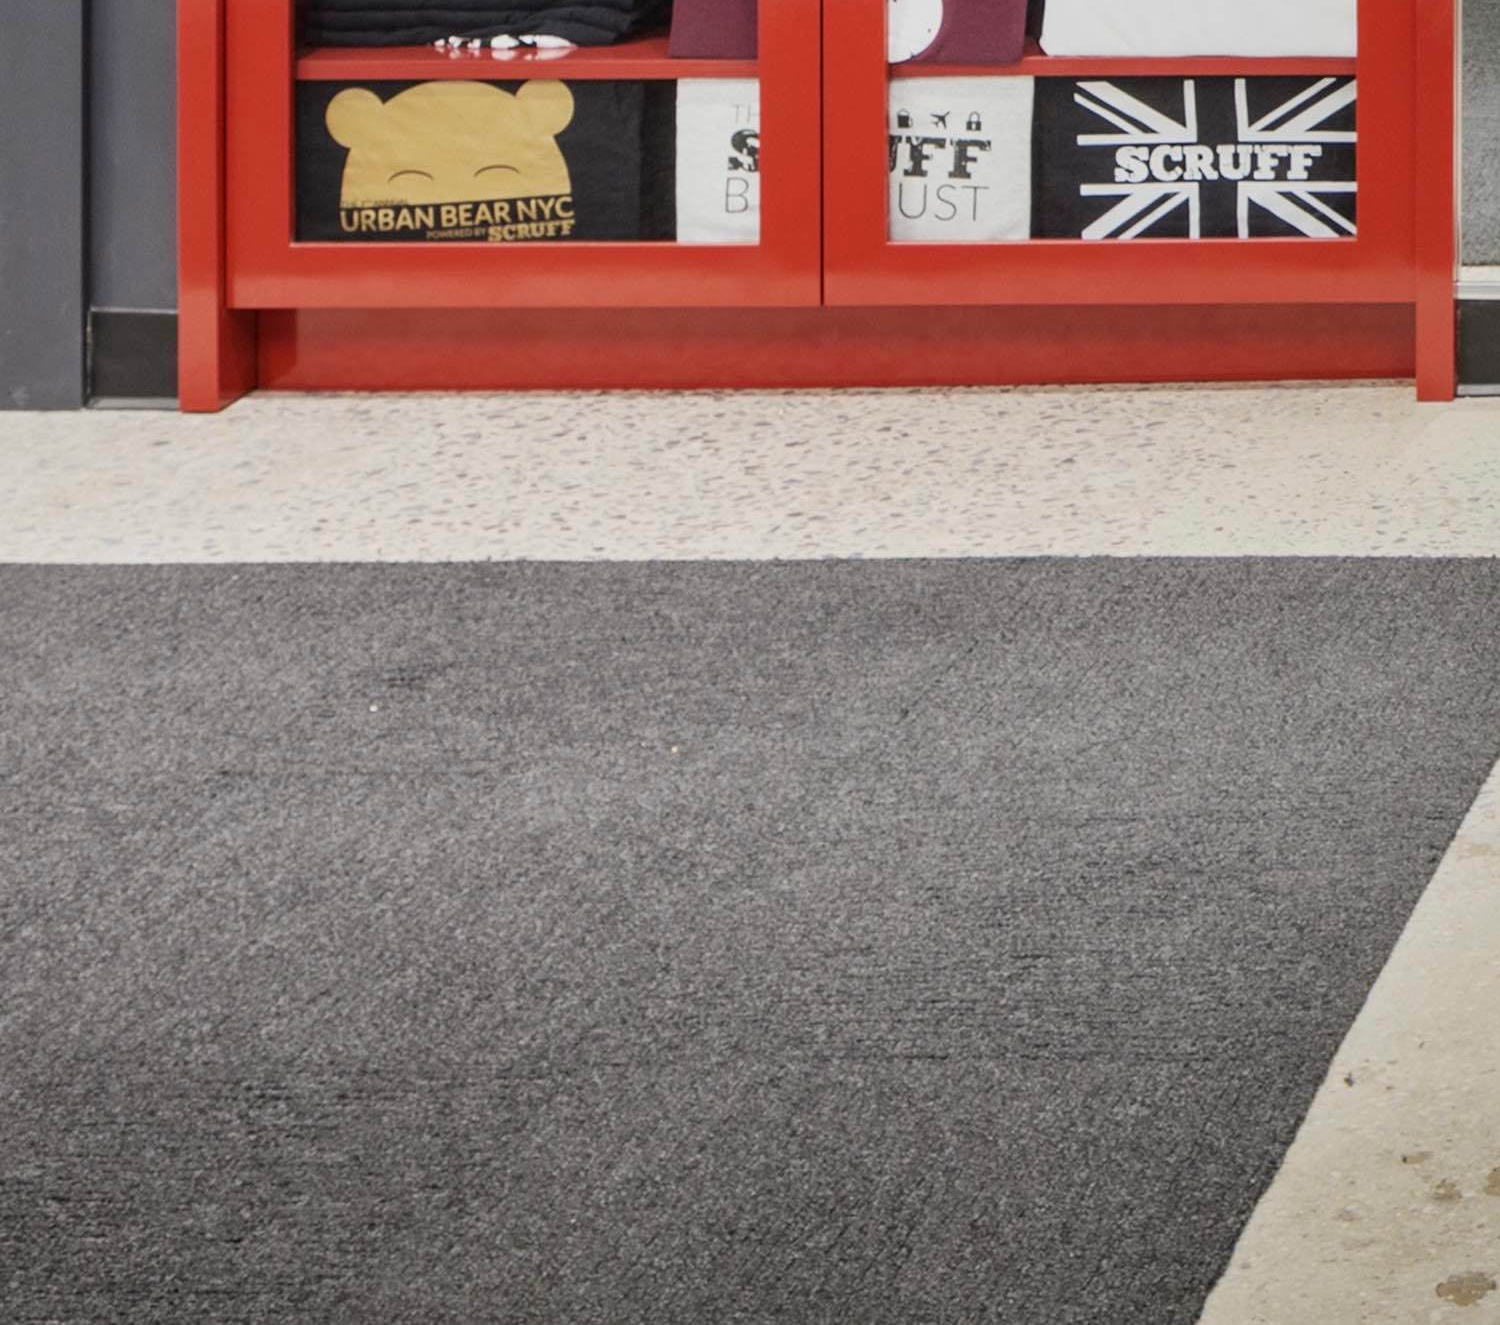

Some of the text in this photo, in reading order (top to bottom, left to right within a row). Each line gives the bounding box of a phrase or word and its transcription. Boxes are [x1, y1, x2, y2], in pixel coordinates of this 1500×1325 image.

[1114, 145, 1323, 183] SCRUFF
[340, 195, 574, 232] URBAN BEAR NYC
[487, 218, 576, 242] SCRUFF
